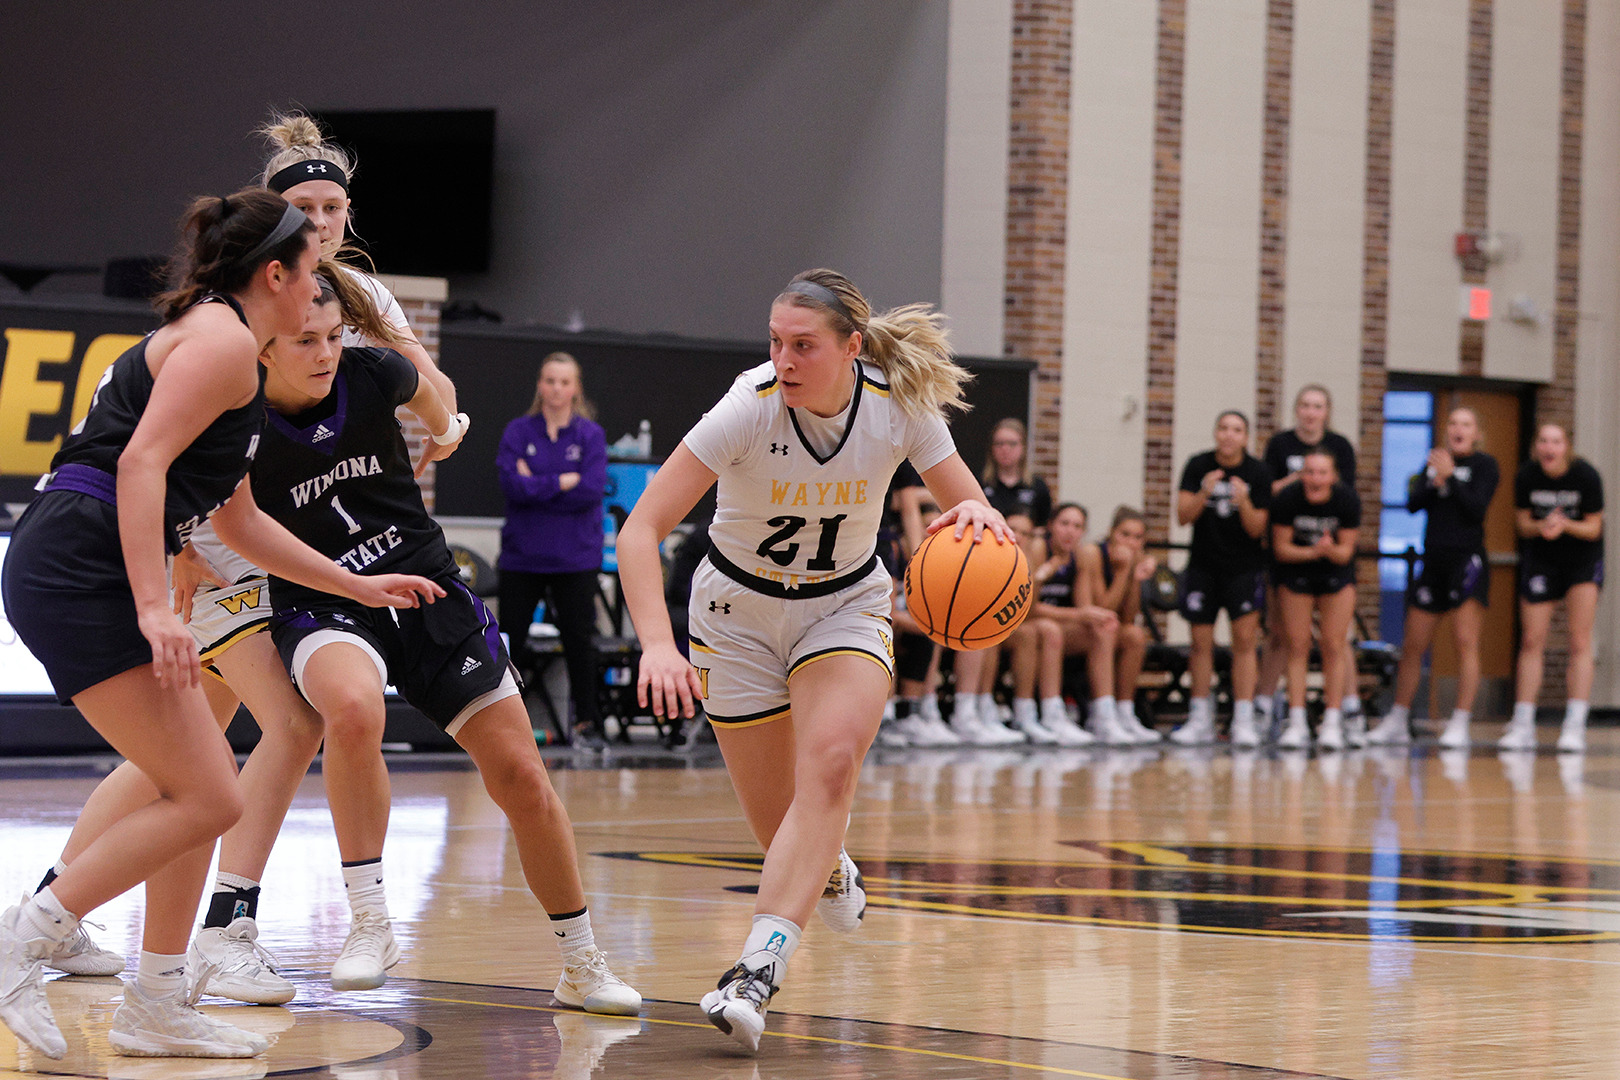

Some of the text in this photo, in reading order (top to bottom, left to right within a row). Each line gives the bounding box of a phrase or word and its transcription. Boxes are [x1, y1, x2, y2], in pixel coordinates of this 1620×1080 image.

[290, 455, 383, 509] WINONA
[770, 479, 868, 506] WAYNE
[330, 495, 362, 536] 1
[756, 514, 848, 571] 21
[992, 578, 1032, 626] Wils
